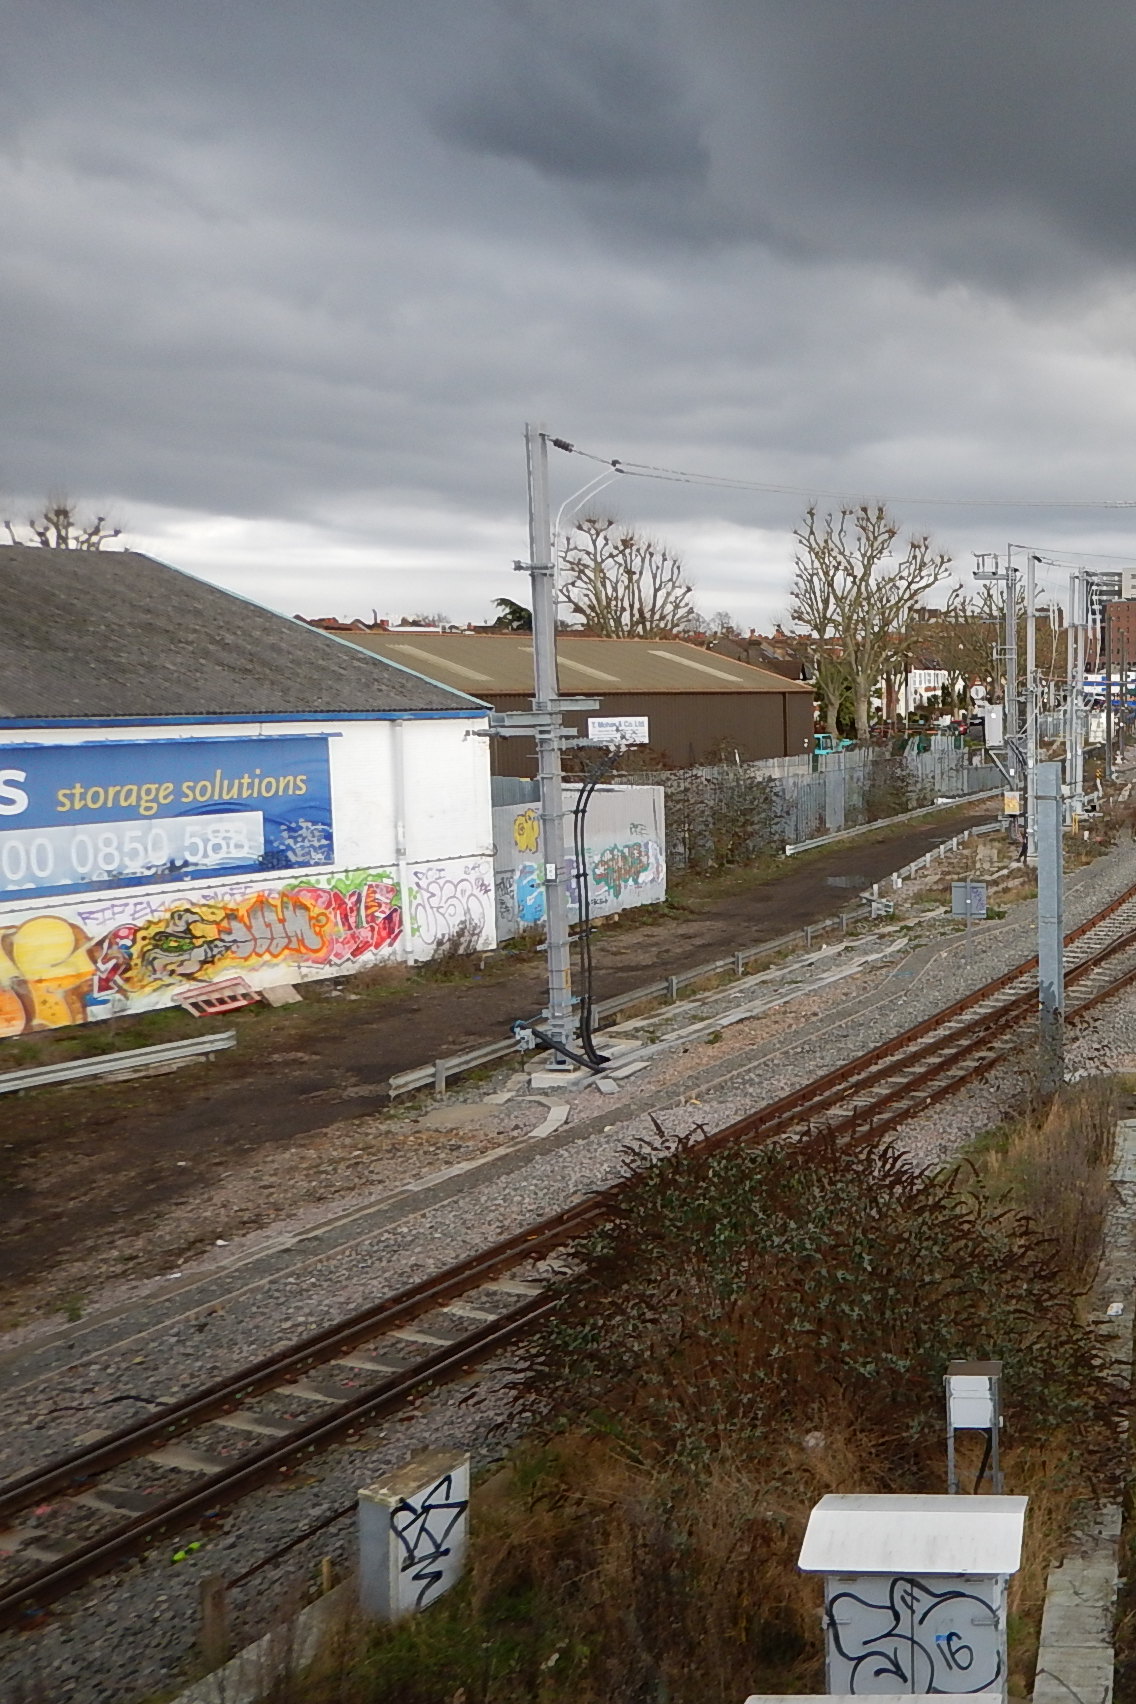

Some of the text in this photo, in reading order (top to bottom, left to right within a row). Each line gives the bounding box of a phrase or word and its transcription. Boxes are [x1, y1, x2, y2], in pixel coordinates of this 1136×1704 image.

[57, 783, 174, 815] storage
[182, 769, 308, 802] solutions
[71, 828, 170, 873] 0850
[936, 1631, 974, 1671] 16
